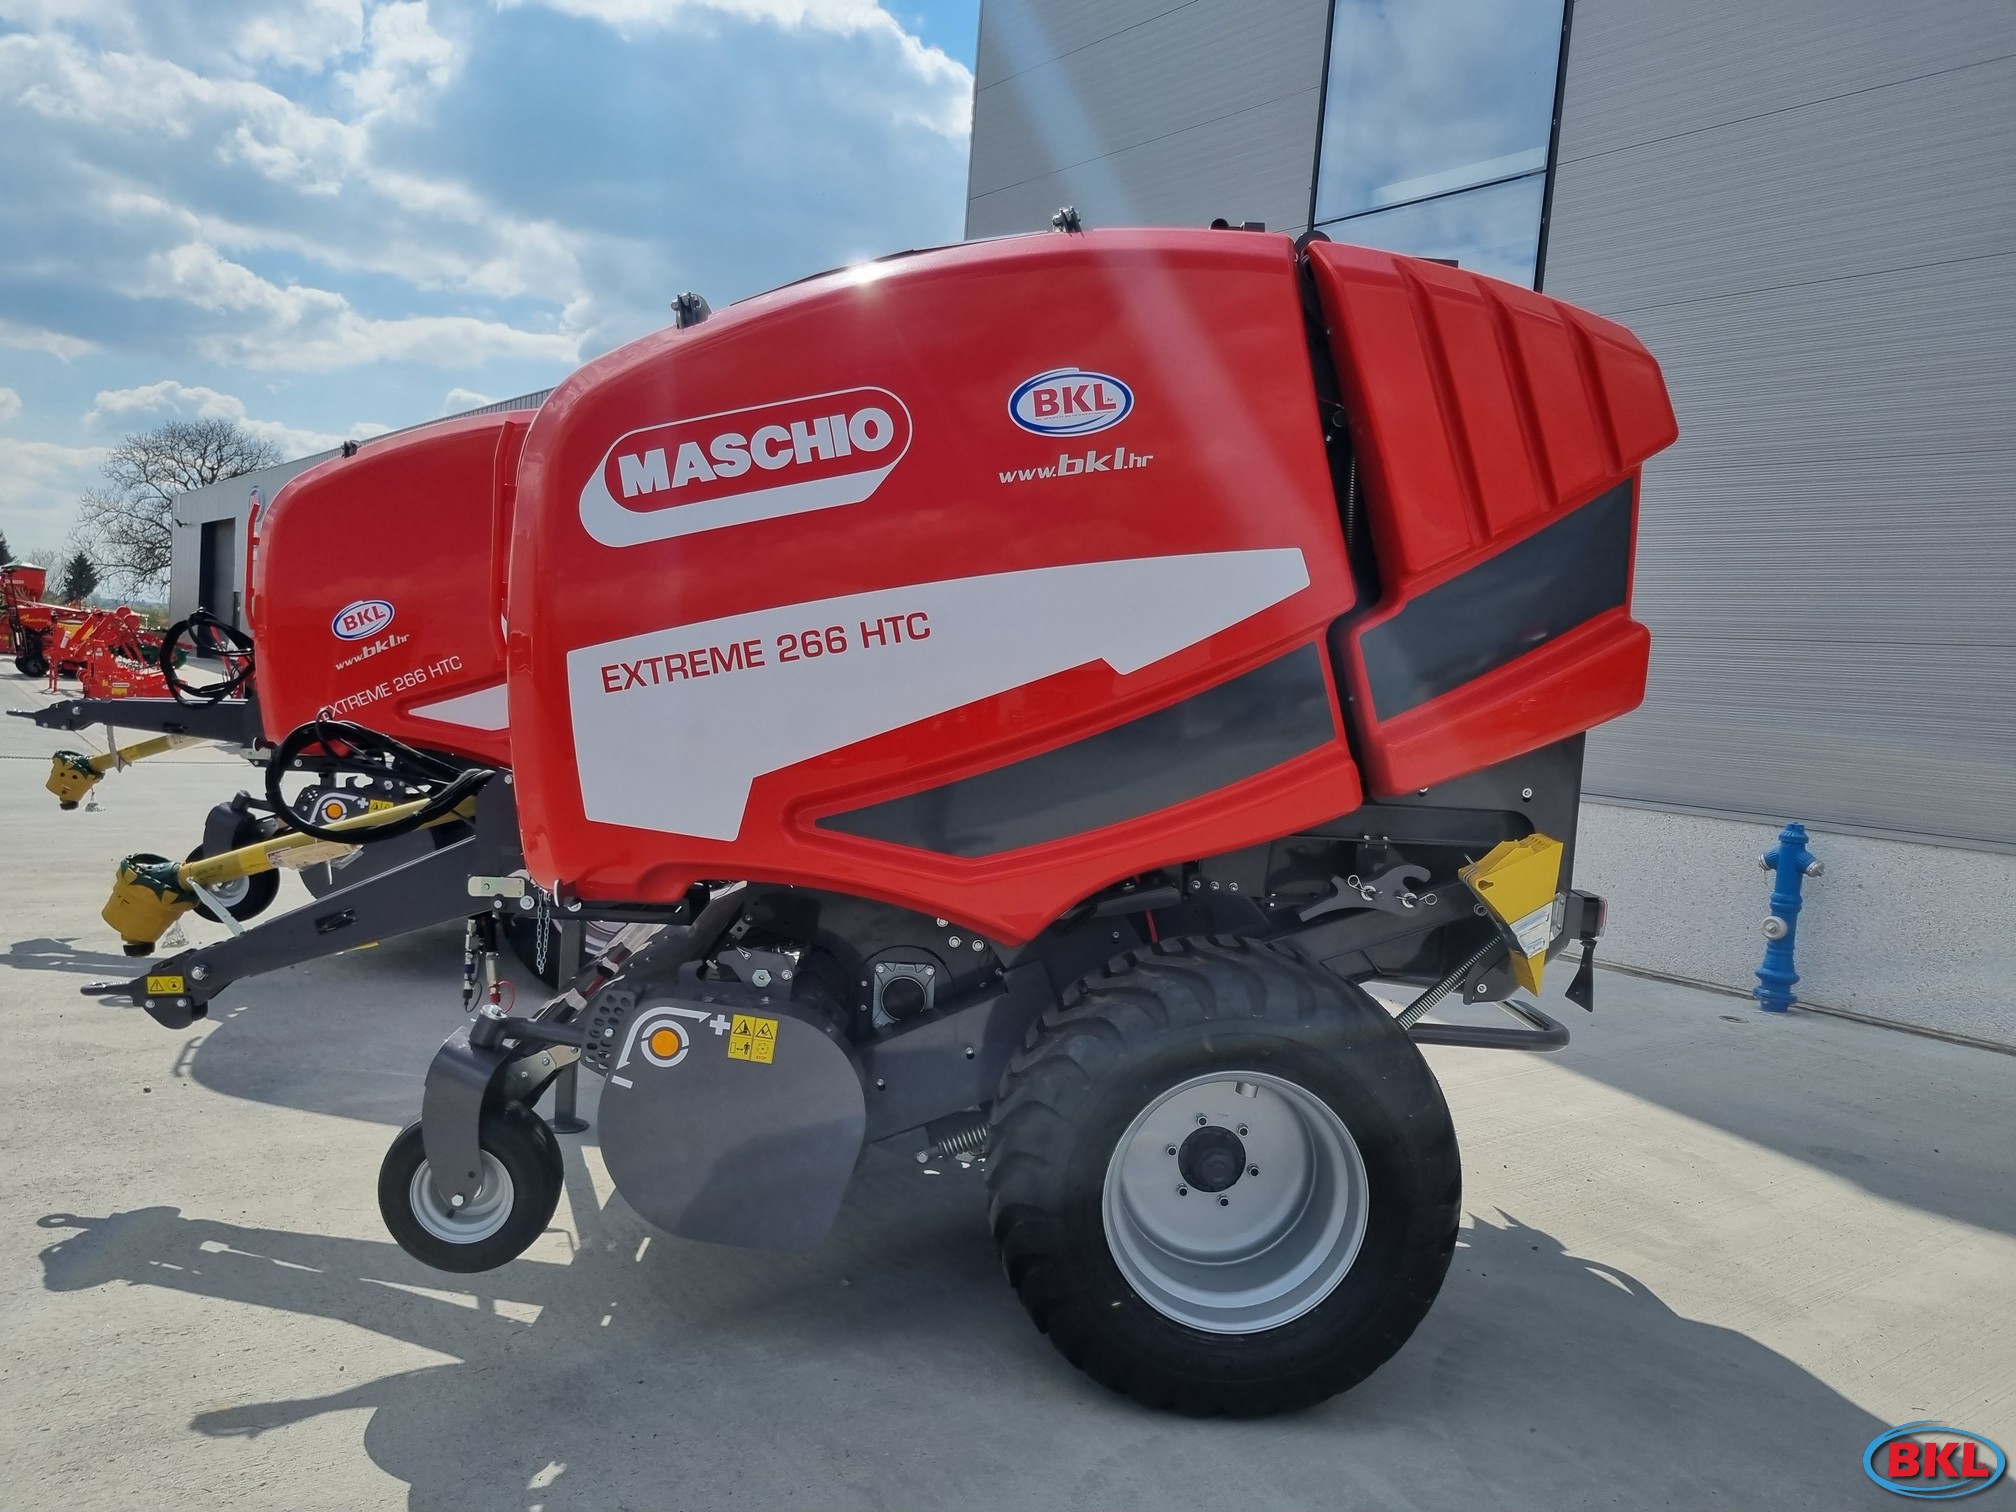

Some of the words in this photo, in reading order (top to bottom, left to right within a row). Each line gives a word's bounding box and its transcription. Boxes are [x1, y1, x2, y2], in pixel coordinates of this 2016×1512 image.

[1033, 383, 1117, 418] BKL
[617, 407, 895, 498] MASCHIO
[999, 447, 1154, 484] www.bkl.hr
[342, 605, 387, 632] BKL
[335, 634, 410, 671] www.bkl.hr
[601, 639, 766, 693] EXTREME
[776, 626, 848, 663] 266
[859, 611, 931, 649] HTC
[393, 668, 427, 692] 266
[428, 655, 463, 679] HTC
